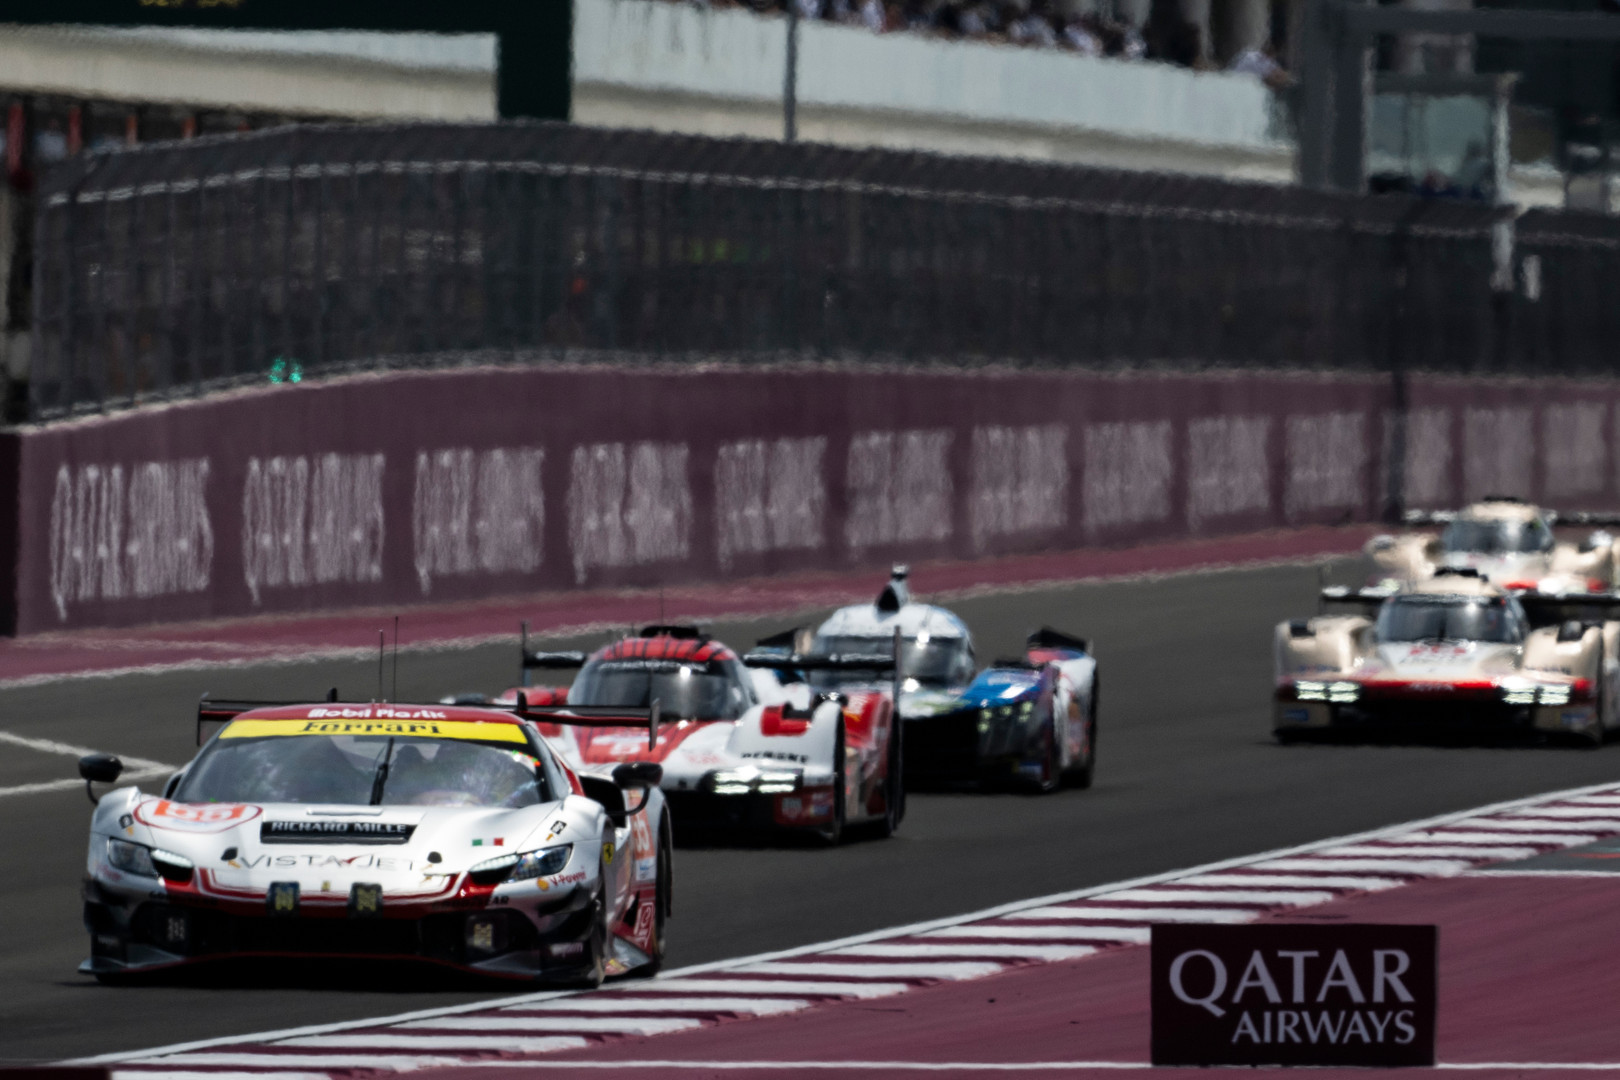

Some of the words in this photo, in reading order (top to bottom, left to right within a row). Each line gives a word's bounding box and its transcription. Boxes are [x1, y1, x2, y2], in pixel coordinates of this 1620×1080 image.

[307, 708, 372, 719] Mobil
[301, 721, 443, 734] Ferrari
[270, 821, 349, 833] RICHARD
[353, 822, 407, 834] MILLE
[1169, 949, 1416, 1017] QATAR
[1231, 1010, 1416, 1044] AIRWAYS
